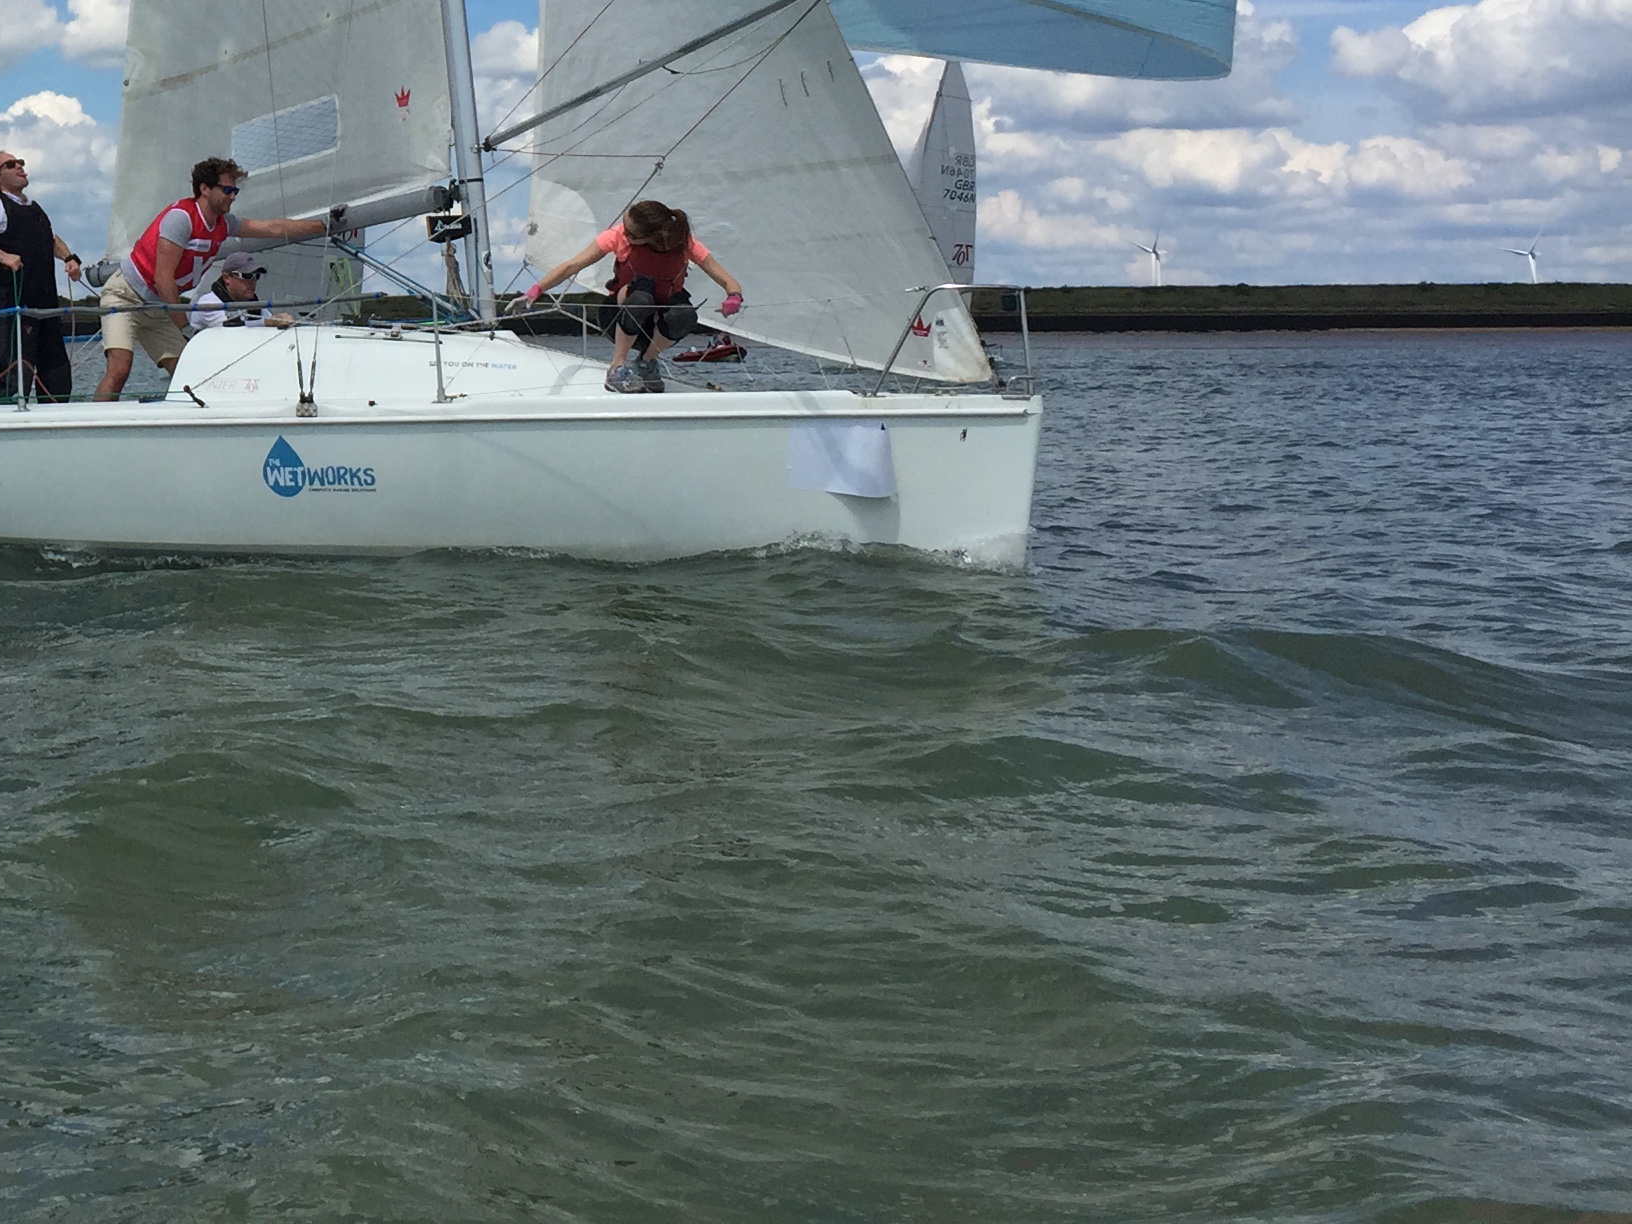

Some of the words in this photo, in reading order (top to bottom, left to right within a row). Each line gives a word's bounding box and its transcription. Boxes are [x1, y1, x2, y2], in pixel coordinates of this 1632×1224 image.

[955, 179, 976, 191] GBR
[943, 188, 976, 203] 7046N
[952, 243, 973, 266] 707
[268, 458, 280, 467] THE
